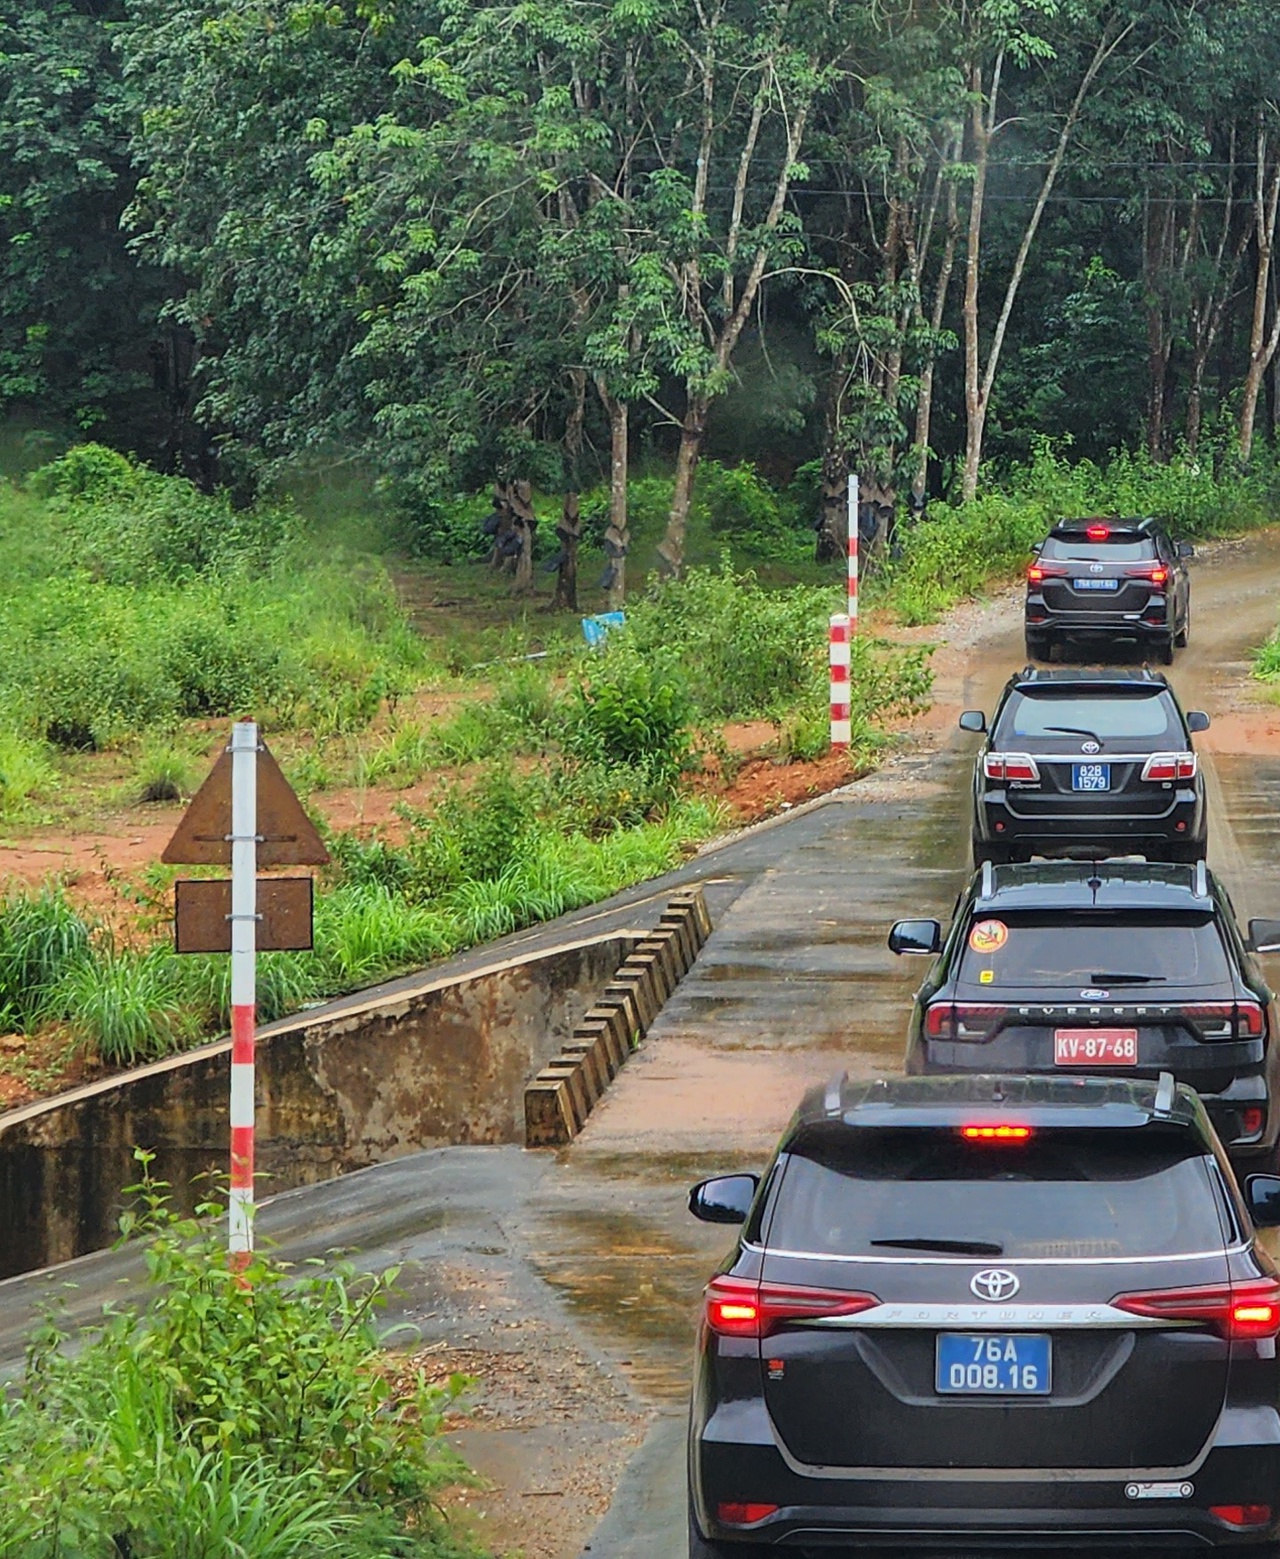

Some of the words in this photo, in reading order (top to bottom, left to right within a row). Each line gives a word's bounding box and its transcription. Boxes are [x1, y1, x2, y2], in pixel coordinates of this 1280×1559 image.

[1080, 765, 1102, 777] 82B
[1078, 777, 1106, 789] 1579
[1019, 1007, 1170, 1016] EVEREST
[1057, 1038, 1135, 1058] KV-87-68
[886, 1309, 1103, 1321] FORTUNER
[971, 1337, 1017, 1363] 76A
[950, 1363, 1038, 1390] 008.16
